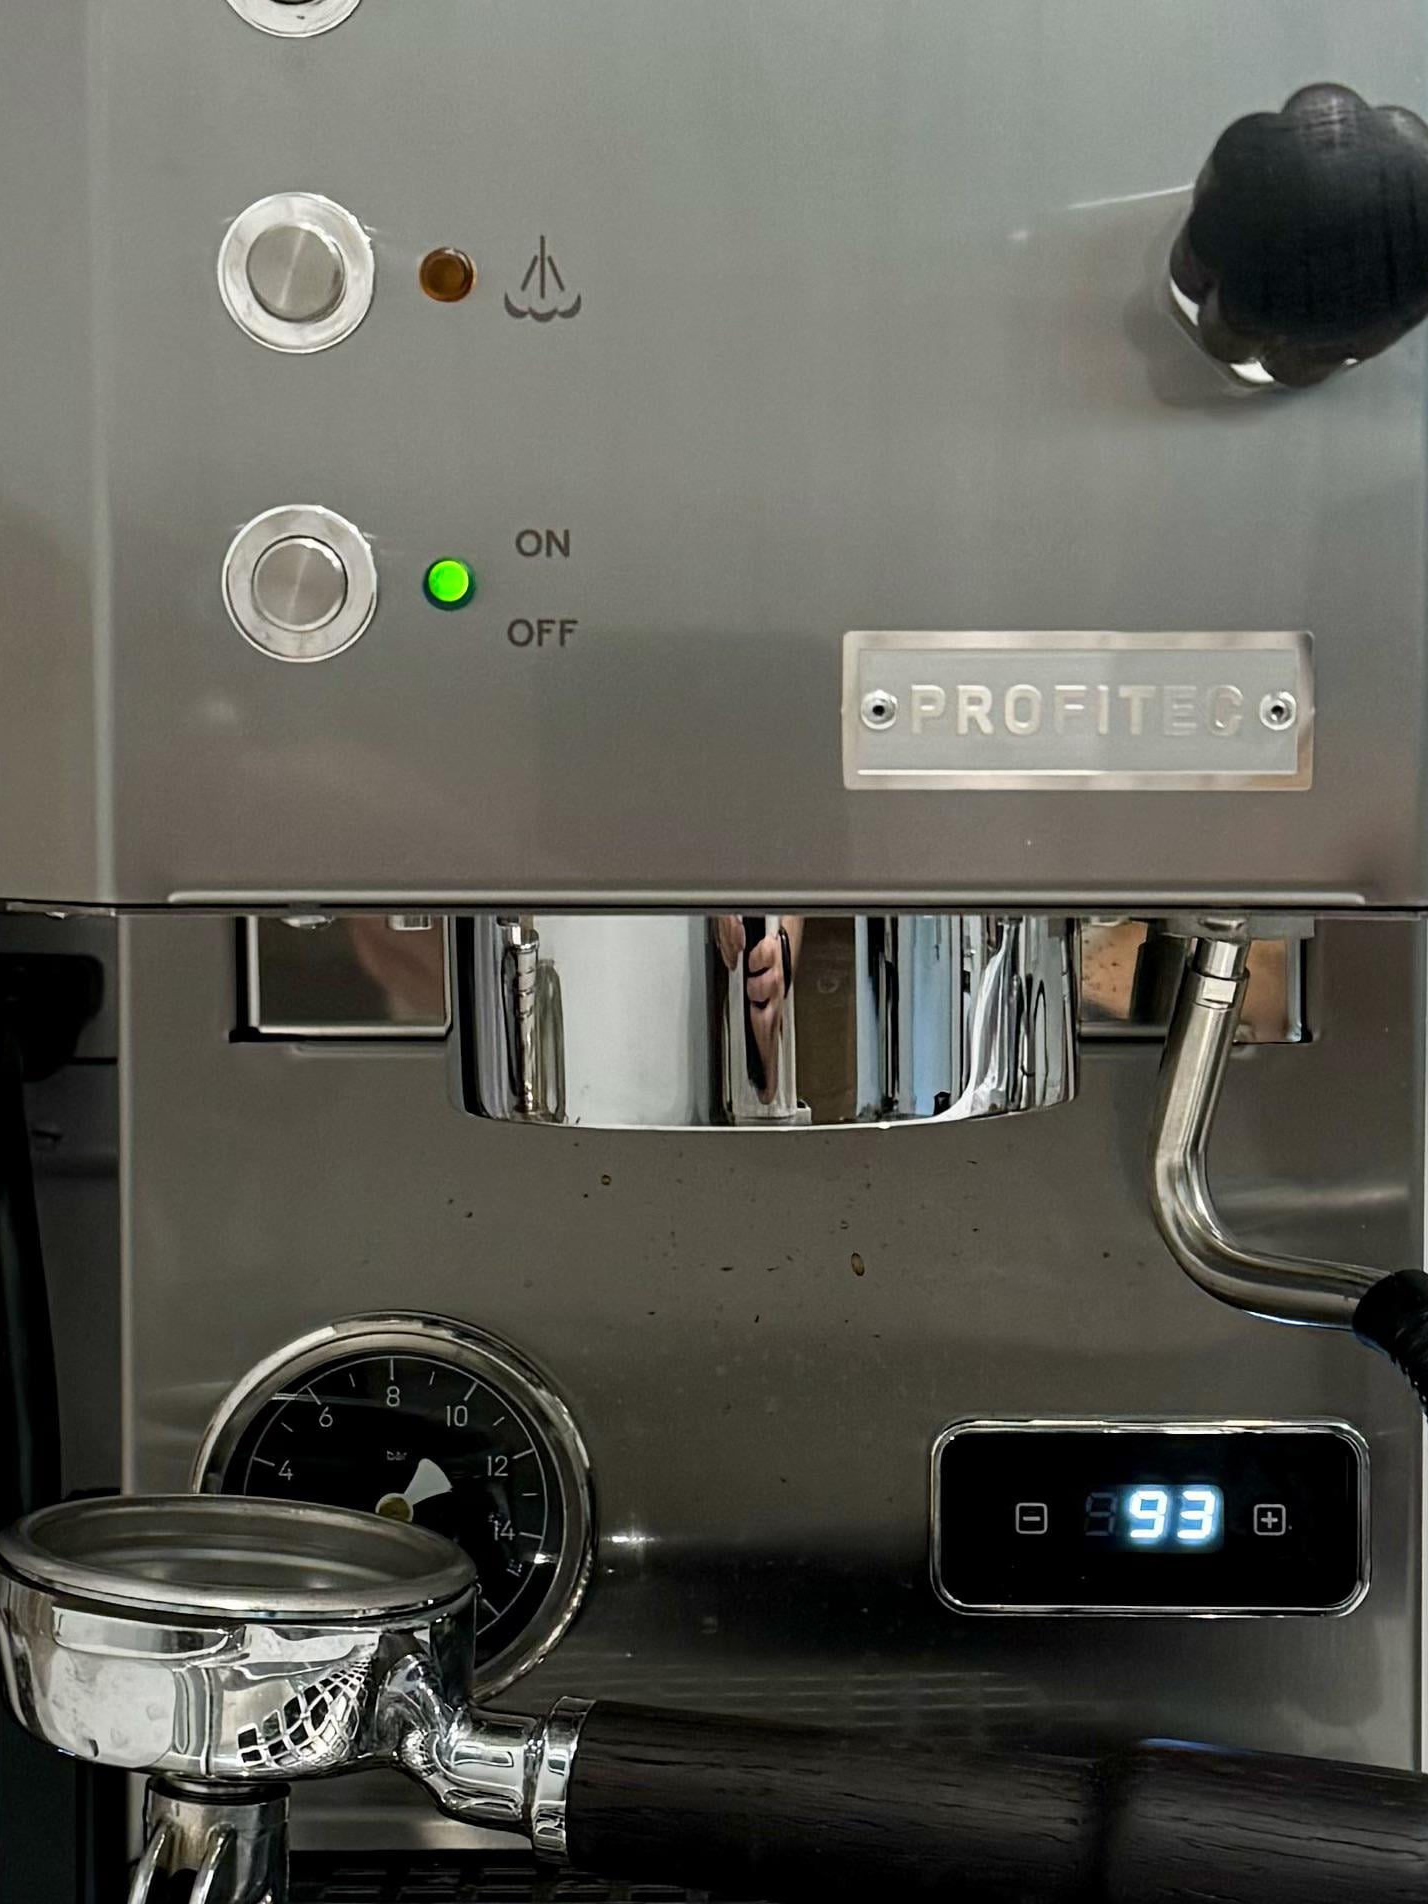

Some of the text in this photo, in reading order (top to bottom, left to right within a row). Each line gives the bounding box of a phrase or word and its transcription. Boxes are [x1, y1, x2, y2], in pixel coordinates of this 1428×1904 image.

[515, 529, 570, 557] ON
[507, 618, 578, 647] OFF
[911, 684, 1244, 736] PROFITEC
[386, 1385, 401, 1407] 8
[318, 1406, 334, 1427] 6
[446, 1405, 469, 1427] 10
[386, 1449, 408, 1461] bar
[487, 1455, 509, 1476] 12
[278, 1459, 294, 1480] 4
[1129, 1490, 1216, 1539] 93
[493, 1519, 517, 1541] 14
